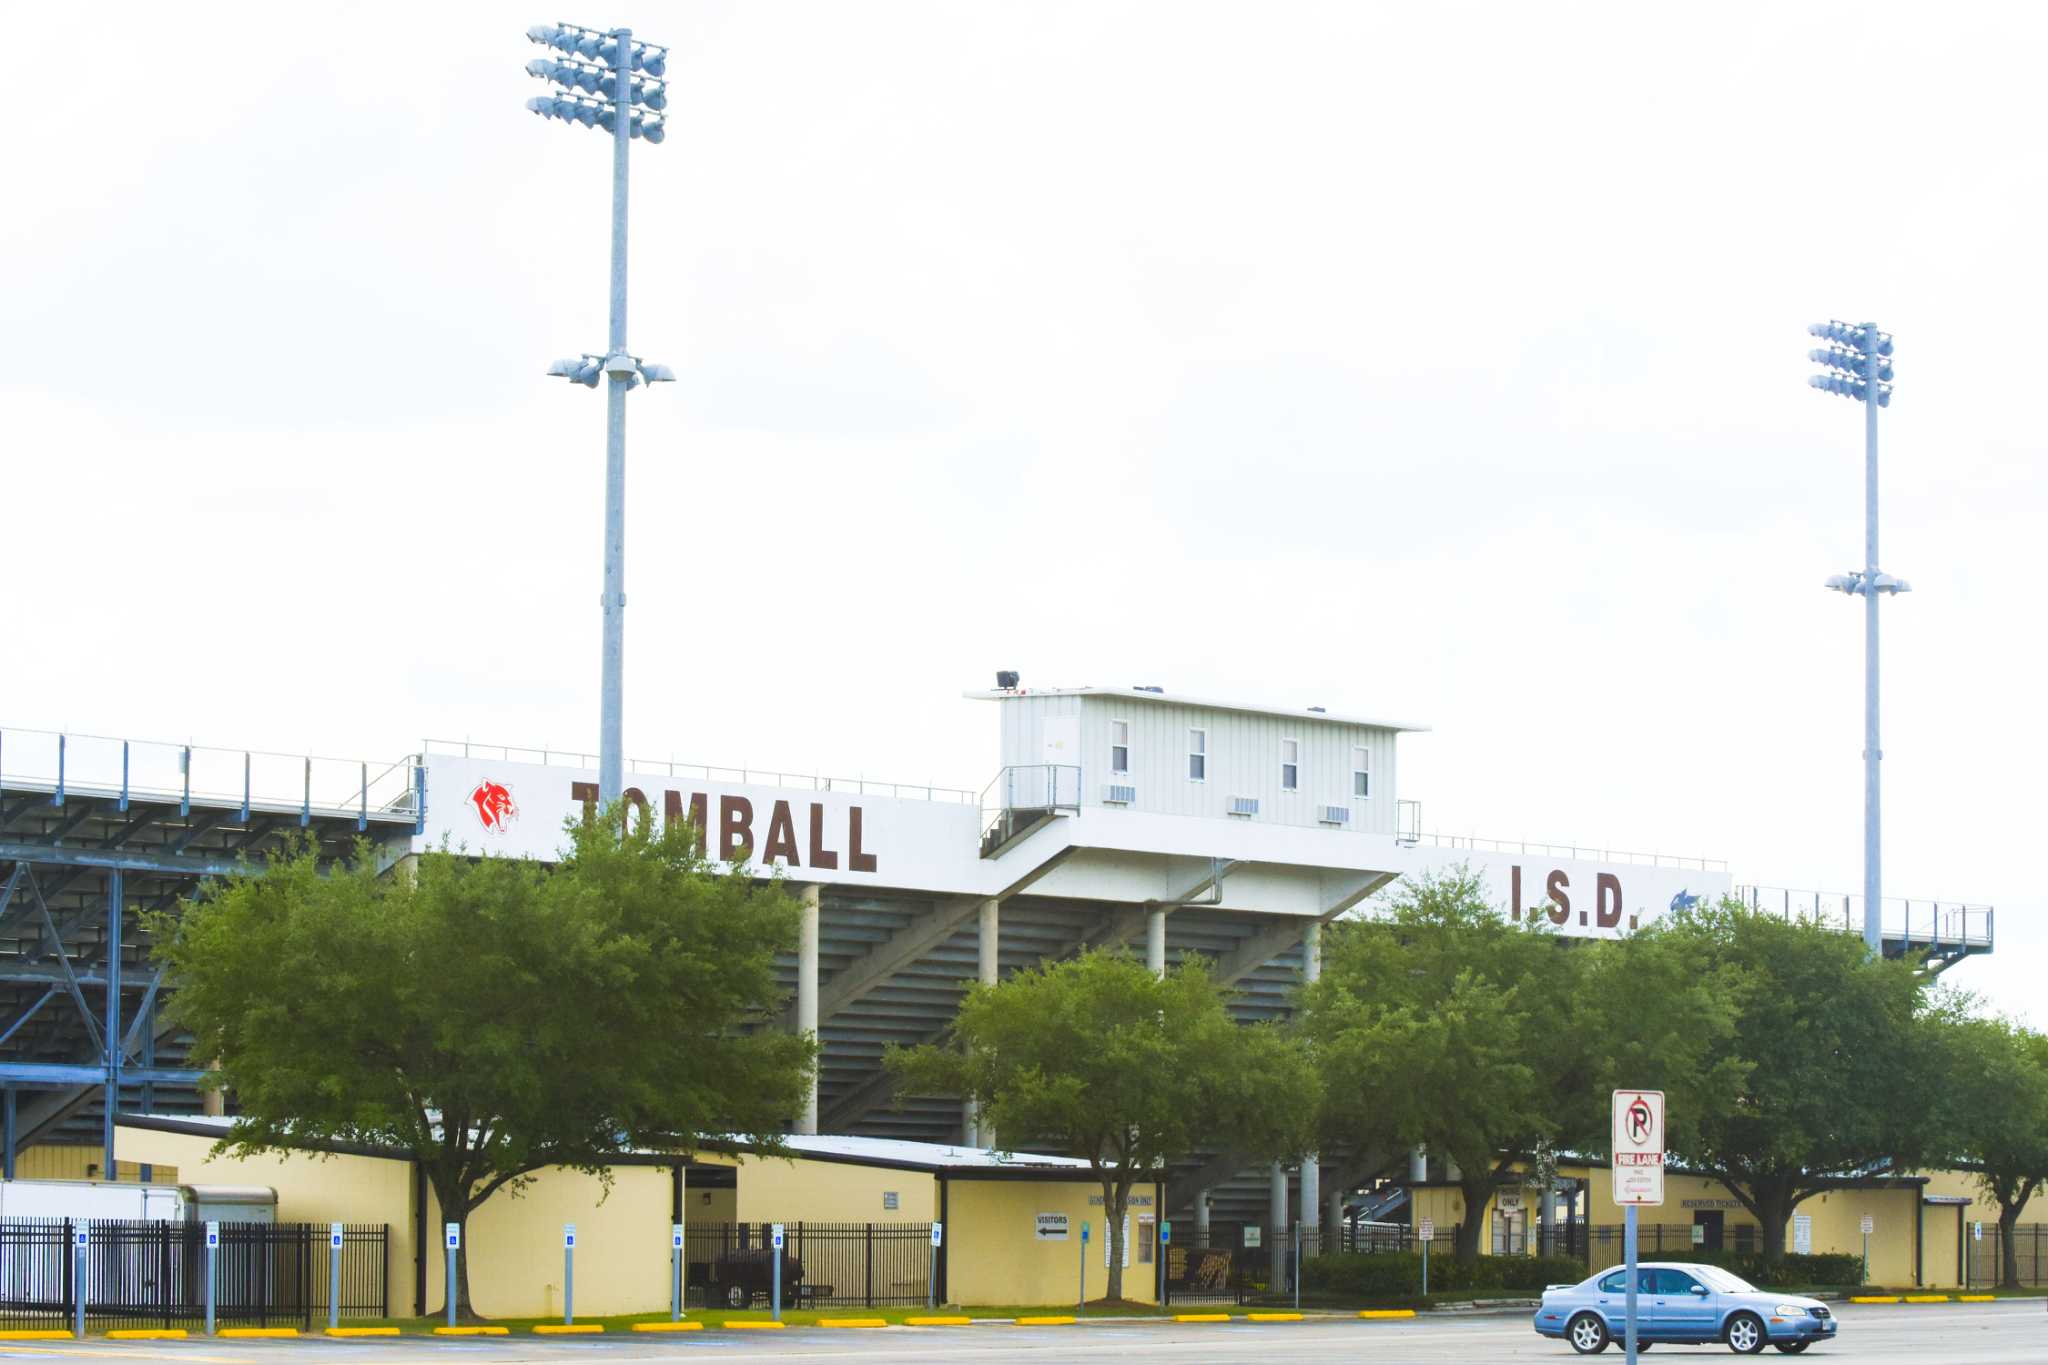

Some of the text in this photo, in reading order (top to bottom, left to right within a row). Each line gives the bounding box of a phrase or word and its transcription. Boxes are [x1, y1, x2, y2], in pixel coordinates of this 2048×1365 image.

[572, 781, 877, 873] TOMBALL
[1511, 865, 1638, 930] I.S.D.
[1618, 1153, 1659, 1166] FIRE LANE
[1037, 1215, 1068, 1224] VISITORS
